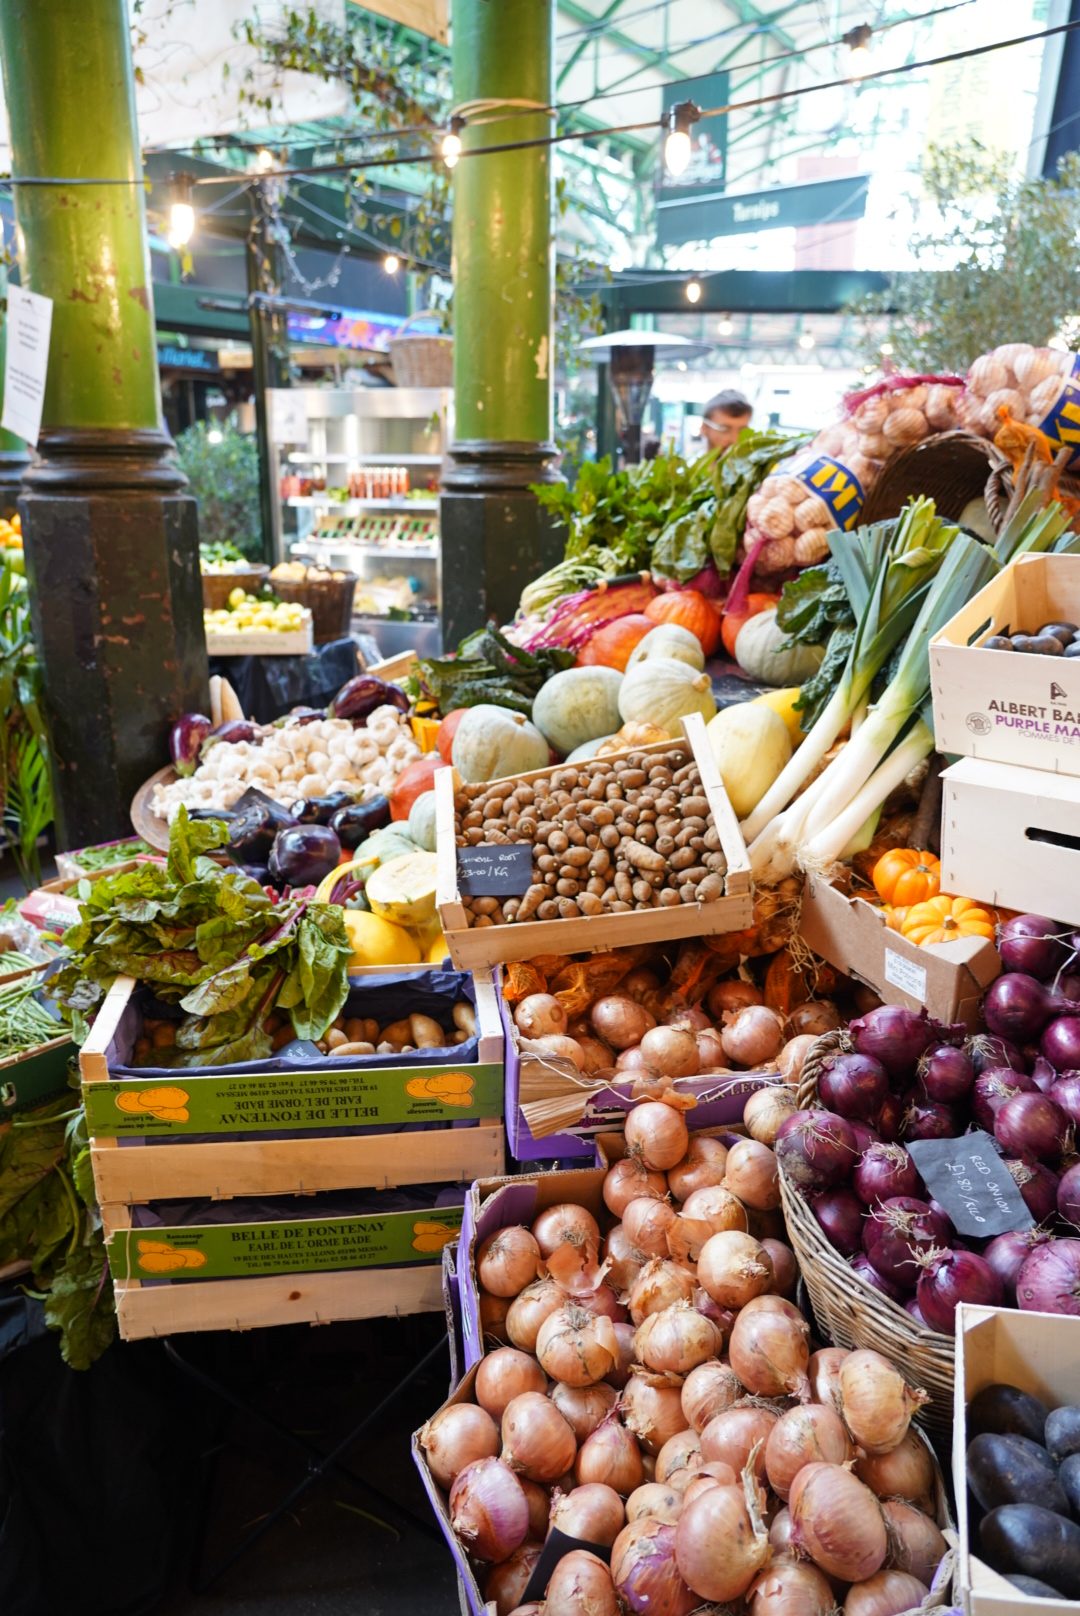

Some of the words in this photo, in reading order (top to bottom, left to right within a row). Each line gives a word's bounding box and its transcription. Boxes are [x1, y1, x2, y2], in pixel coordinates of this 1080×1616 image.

[988, 699, 1047, 719] ALBERT
[995, 715, 1050, 733] PURPLE
[1018, 729, 1059, 743] POMMES
[1063, 736, 1075, 746] DE
[271, 1088, 304, 1096] TALONS
[234, 1101, 264, 1110] BADE
[314, 1097, 330, 1107] DE
[332, 1096, 362, 1105] EARL
[219, 1111, 301, 1124] FONTENAY
[306, 1110, 325, 1120] DE
[331, 1107, 379, 1119] BELLE
[969, 1155, 991, 1175] RED
[986, 1181, 1013, 1214] ONION
[231, 1231, 280, 1242] BELLE
[283, 1228, 304, 1239] DE
[307, 1221, 387, 1237] FONTENAY
[248, 1242, 278, 1252] EARL
[280, 1240, 296, 1250] DE
[342, 1235, 372, 1246] BADE
[277, 1252, 304, 1260] HAUTS
